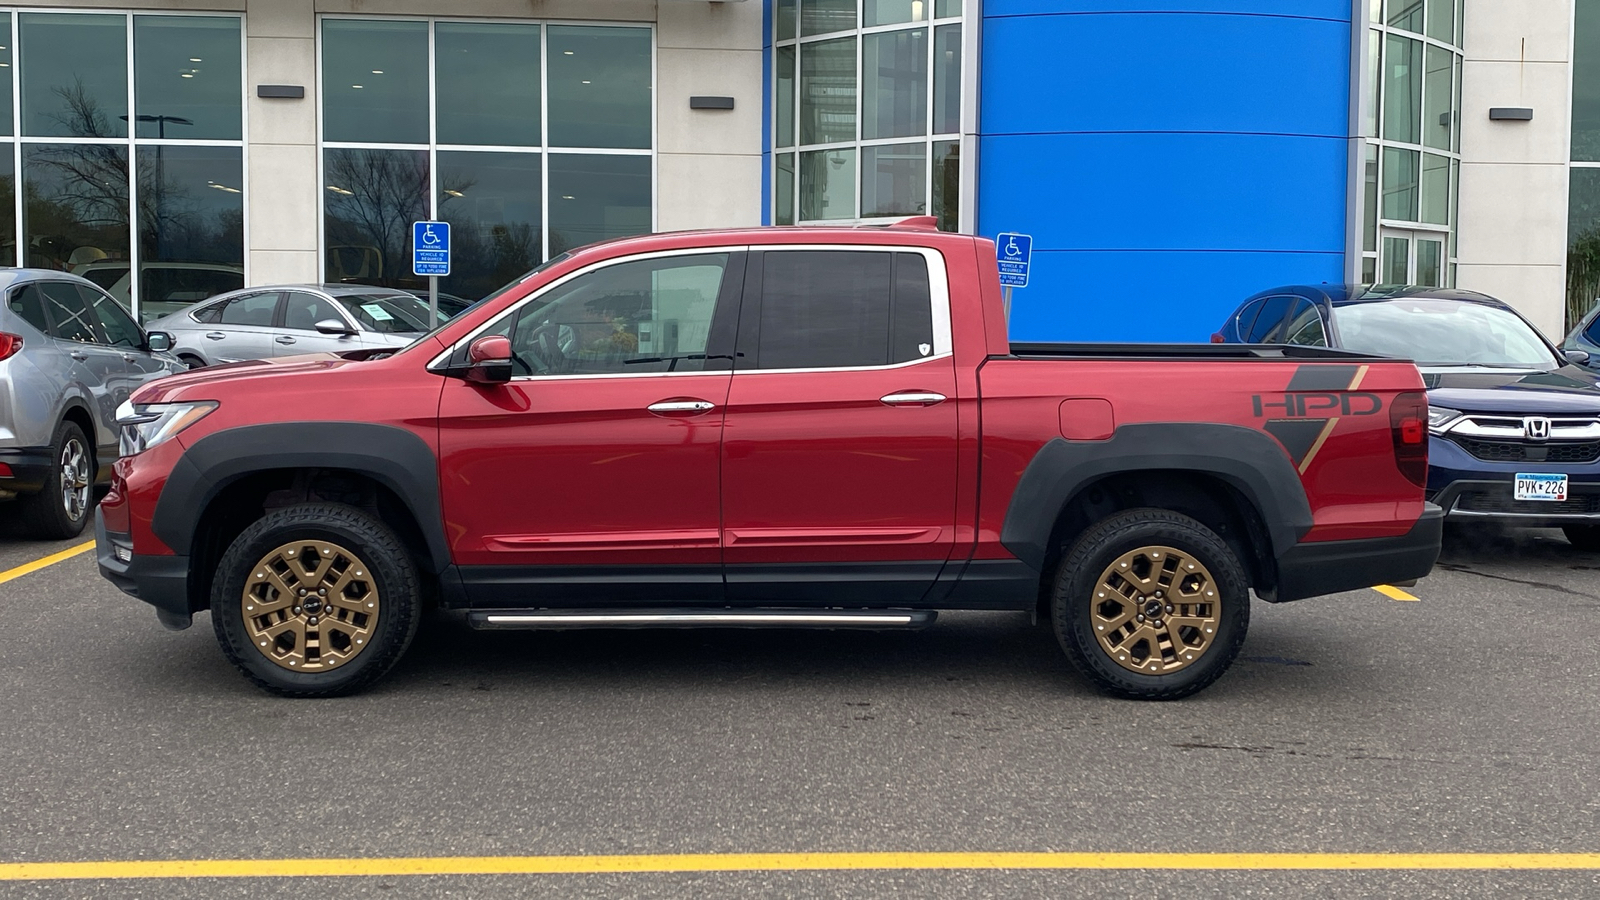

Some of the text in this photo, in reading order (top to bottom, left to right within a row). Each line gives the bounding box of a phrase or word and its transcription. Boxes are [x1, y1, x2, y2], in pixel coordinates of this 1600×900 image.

[1252, 392, 1382, 417] HPD
[1518, 480, 1564, 494] PVK 226
